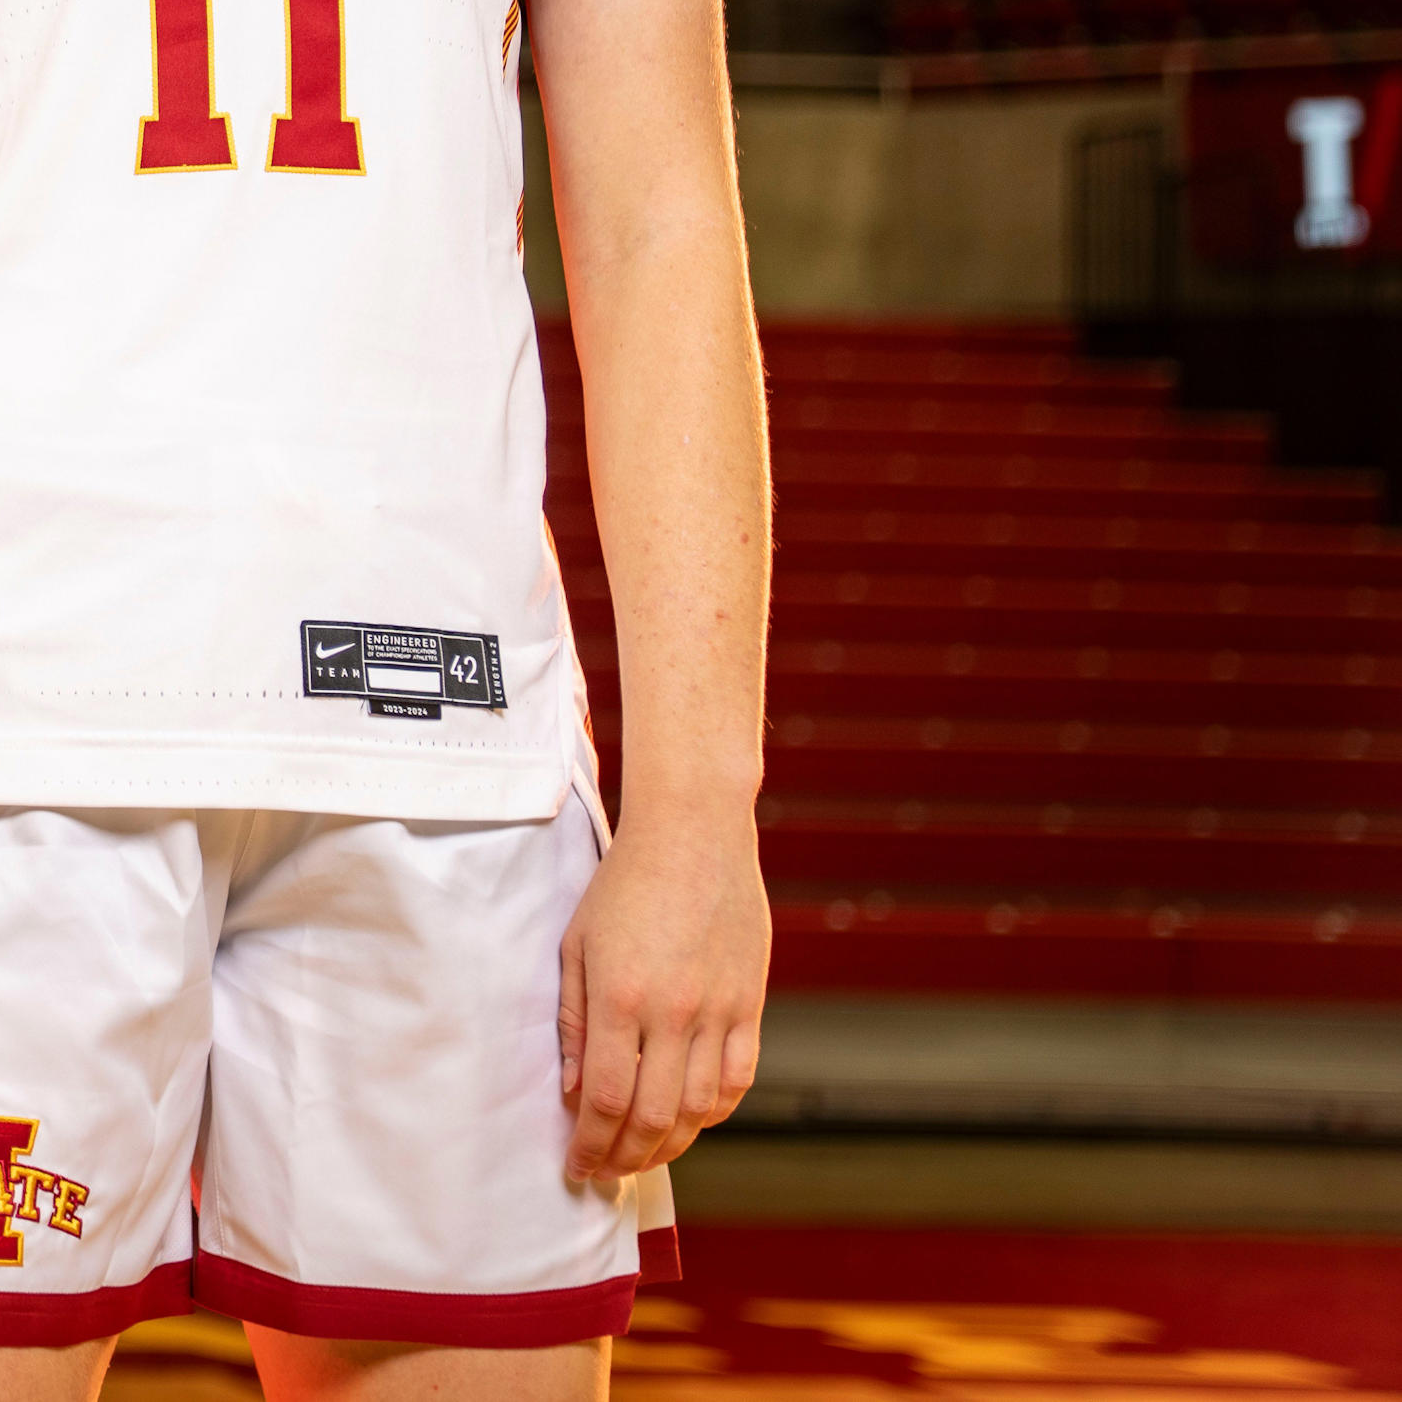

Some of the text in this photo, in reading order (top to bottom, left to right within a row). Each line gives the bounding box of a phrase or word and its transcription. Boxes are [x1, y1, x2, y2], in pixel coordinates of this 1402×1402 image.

[366, 633, 437, 649] ENGINEERED
[315, 666, 361, 679] TEAM
[449, 654, 480, 685] 42
[491, 658, 504, 702] LENGTH
[382, 704, 429, 717] 2023-2024
